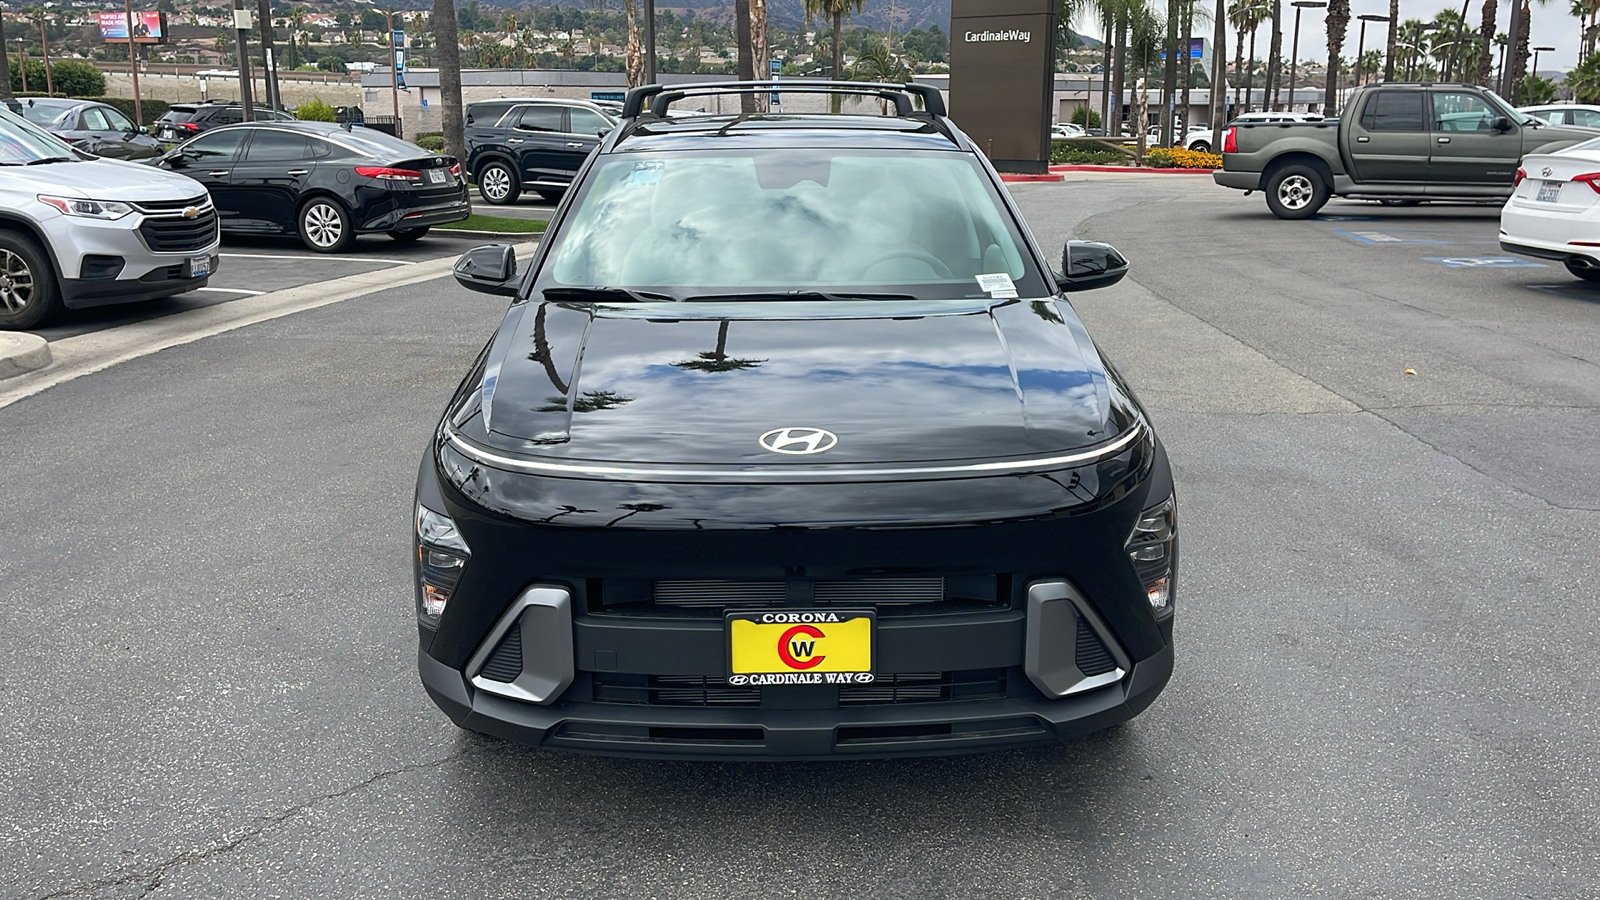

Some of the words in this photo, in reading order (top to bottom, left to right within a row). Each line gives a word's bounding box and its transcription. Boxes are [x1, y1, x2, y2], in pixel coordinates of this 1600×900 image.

[964, 29, 1031, 43] CardinaleWay
[762, 612, 839, 624] CORONA
[749, 673, 823, 685] CARDINALE
[825, 672, 854, 685] WAY
